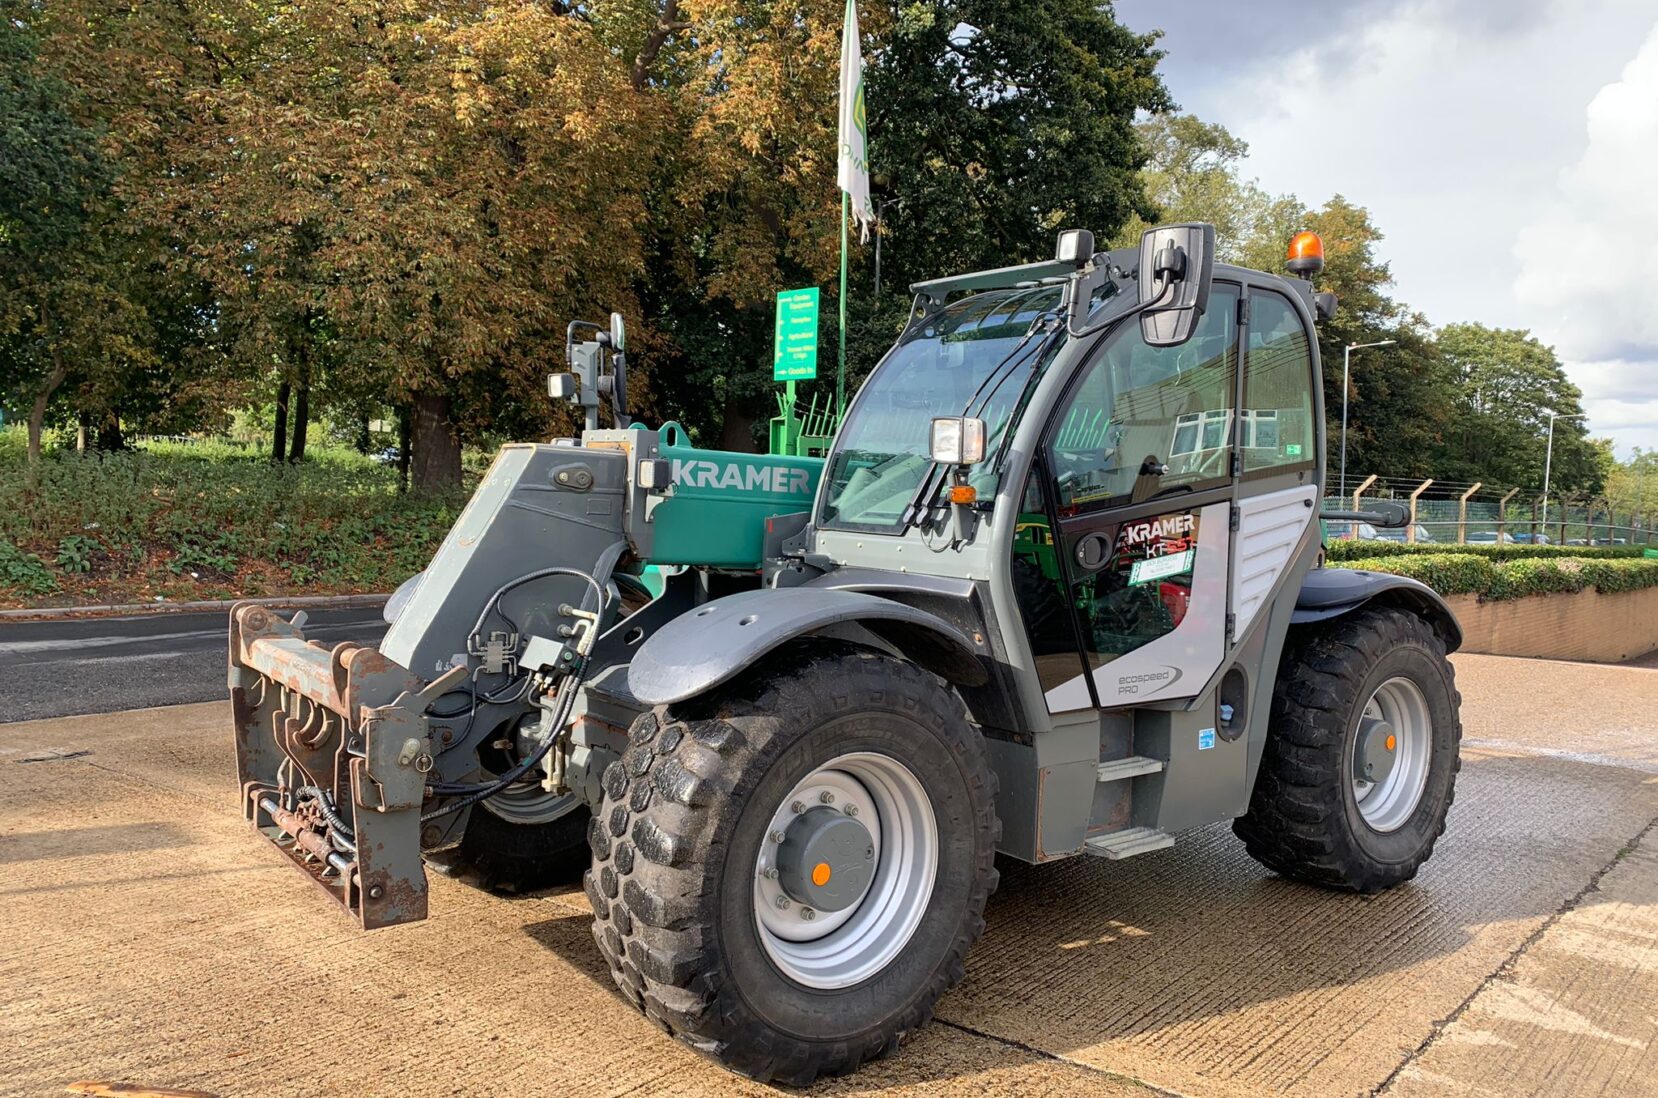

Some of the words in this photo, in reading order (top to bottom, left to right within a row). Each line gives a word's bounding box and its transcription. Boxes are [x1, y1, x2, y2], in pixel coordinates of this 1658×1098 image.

[672, 459, 811, 494] KRAMER
[1127, 514, 1195, 544] KRAMER
[1118, 671, 1169, 685] ecospeed
[1118, 685, 1139, 695] PRO
